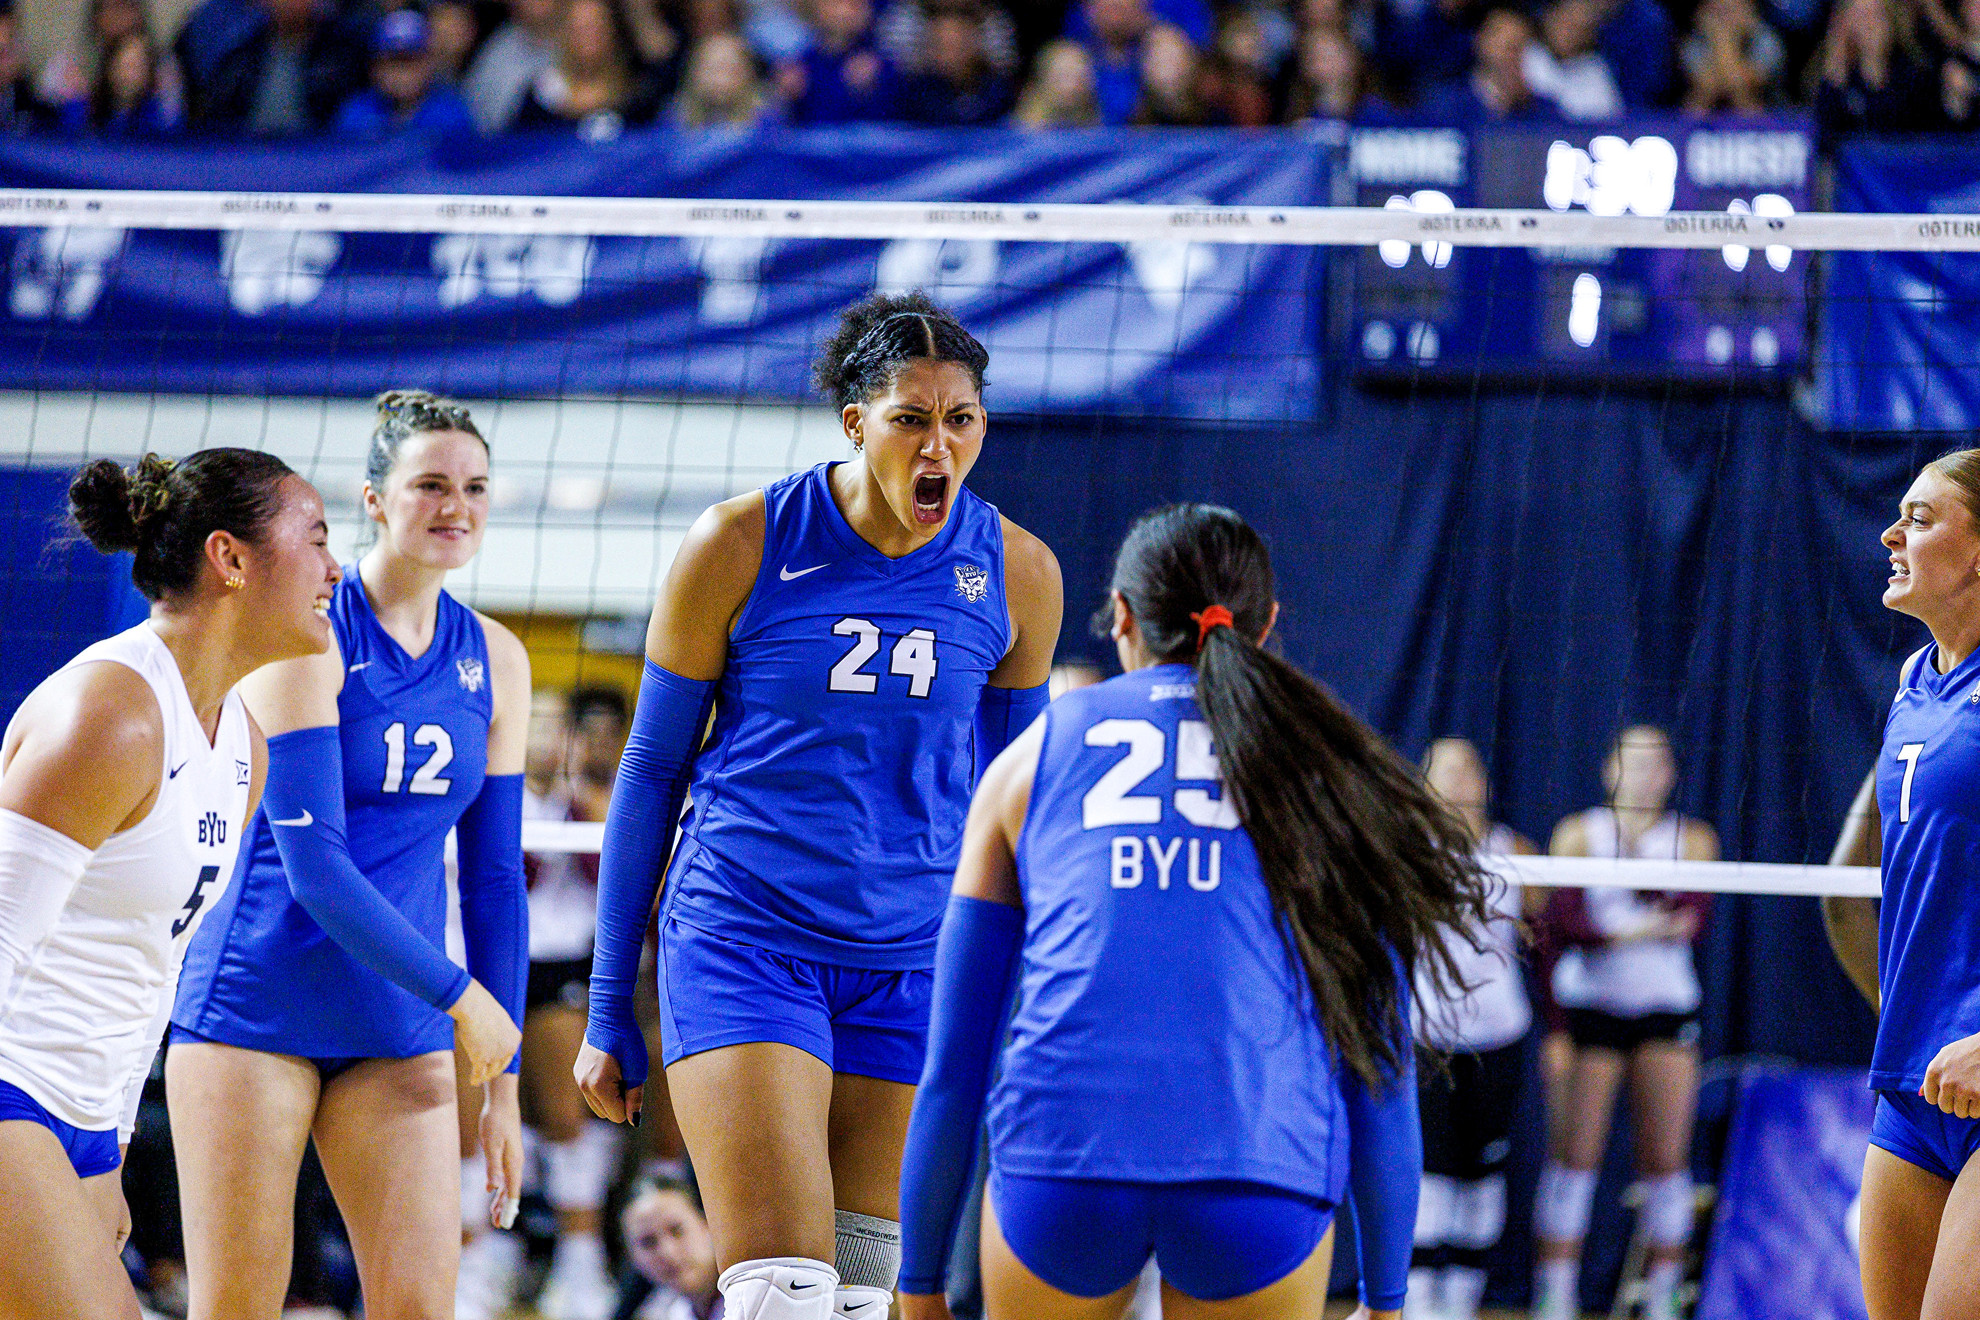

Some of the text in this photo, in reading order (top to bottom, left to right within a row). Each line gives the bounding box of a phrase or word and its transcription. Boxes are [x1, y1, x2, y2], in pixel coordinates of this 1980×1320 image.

[827, 615, 939, 699] 24
[382, 722, 454, 795] 12
[1082, 717, 1241, 831] 25
[198, 812, 227, 847] BYU
[1110, 835, 1222, 892] BYU
[171, 865, 221, 940] 5
